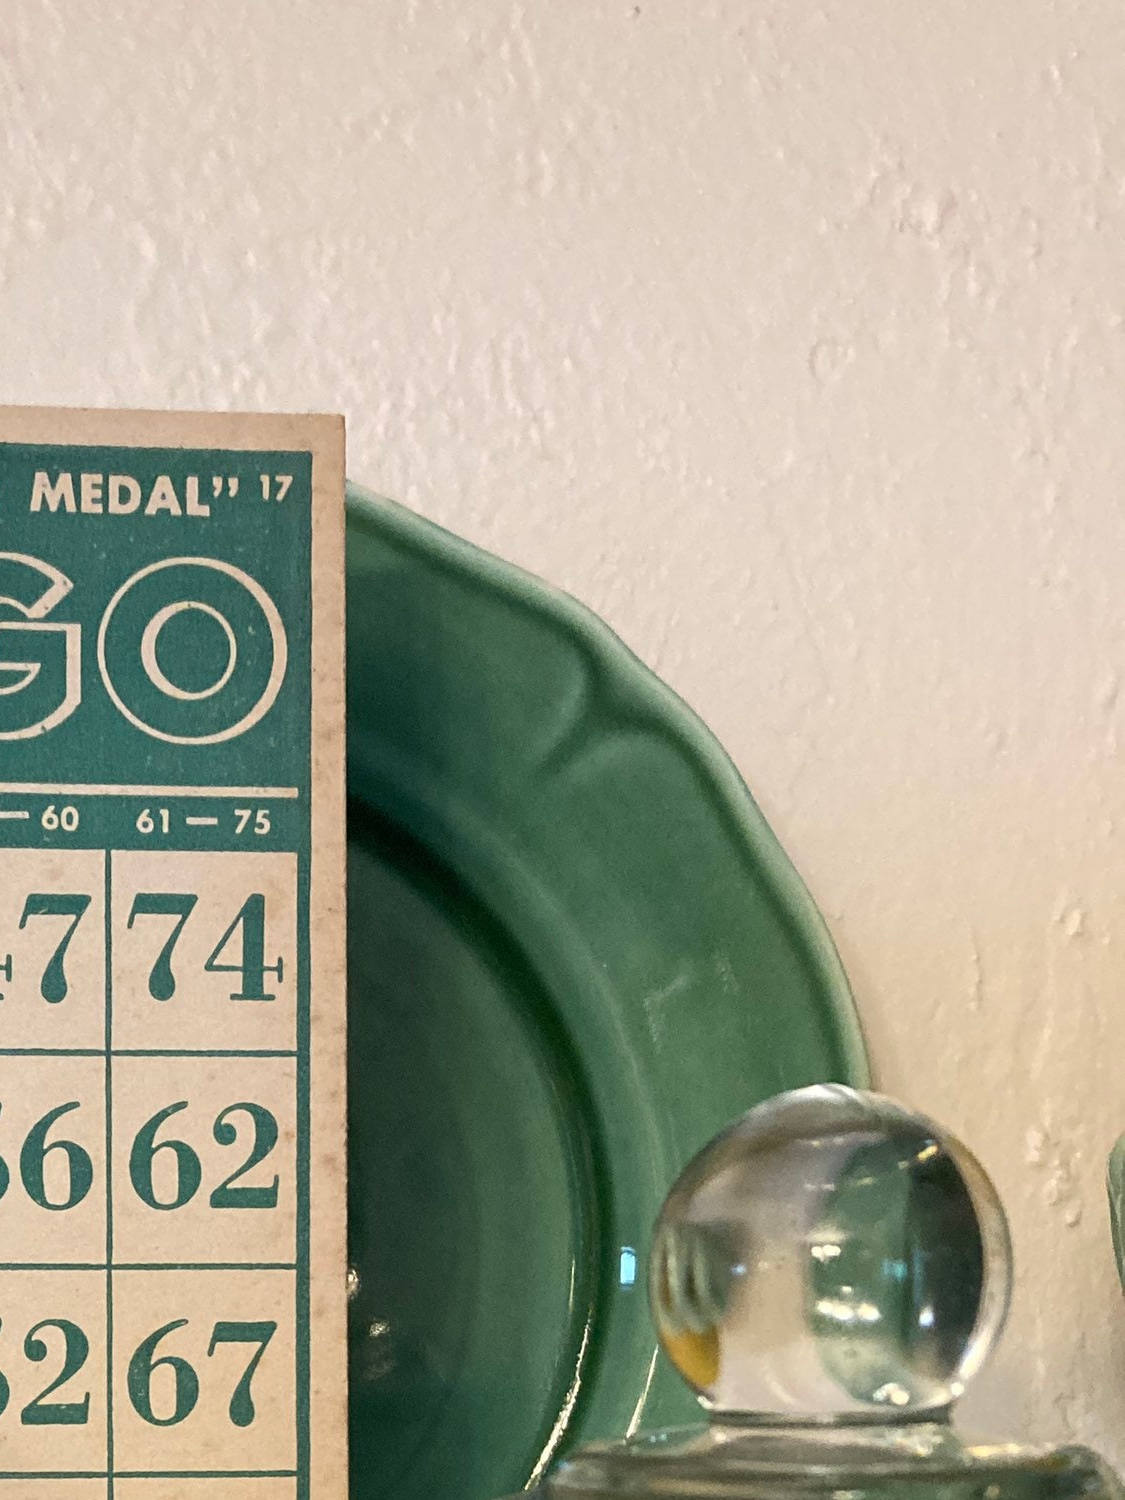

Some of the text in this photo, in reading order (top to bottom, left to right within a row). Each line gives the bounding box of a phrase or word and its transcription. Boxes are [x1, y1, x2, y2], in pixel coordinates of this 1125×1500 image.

[261, 475, 293, 501] 17
[128, 893, 286, 1001] 74
[129, 1102, 280, 1211] 62
[128, 1319, 278, 1427] 67
